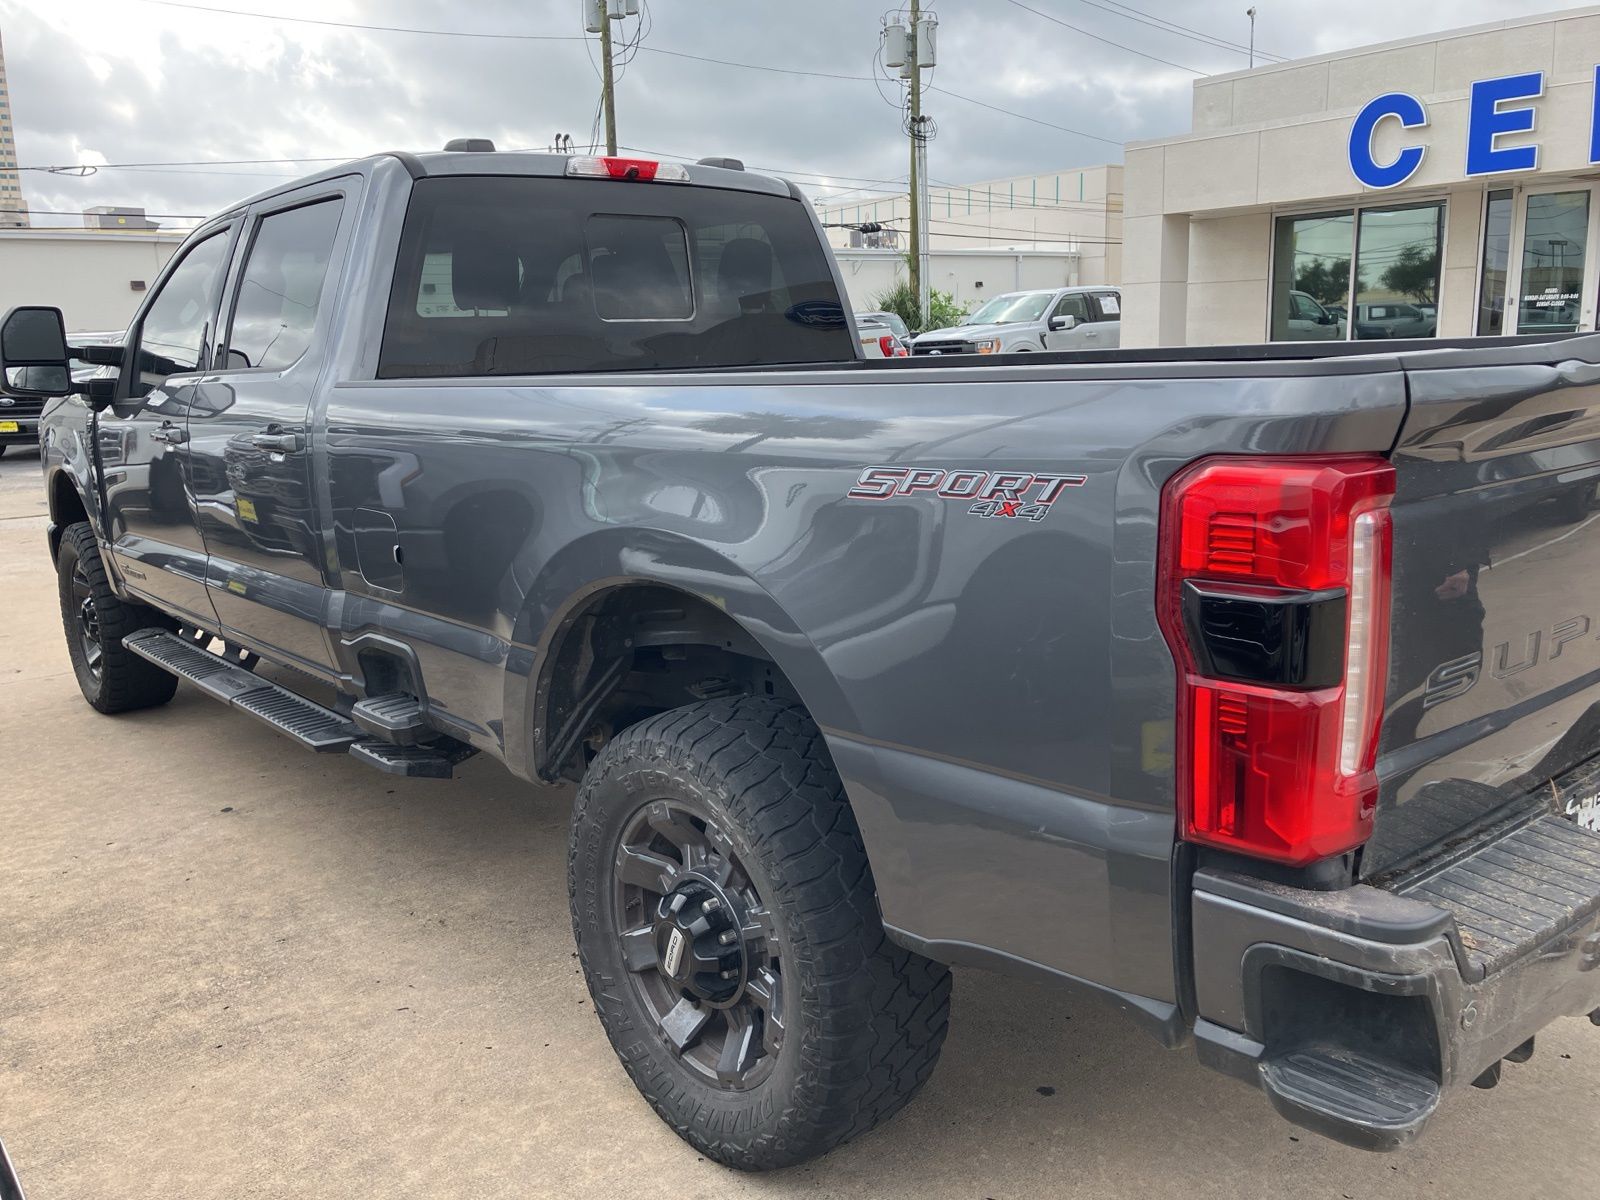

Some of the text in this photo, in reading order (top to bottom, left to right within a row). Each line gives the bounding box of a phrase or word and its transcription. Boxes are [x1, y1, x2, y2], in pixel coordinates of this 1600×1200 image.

[1347, 64, 1600, 190] CE
[847, 466, 1088, 505] SPORT
[1423, 614, 1600, 710] SUP
